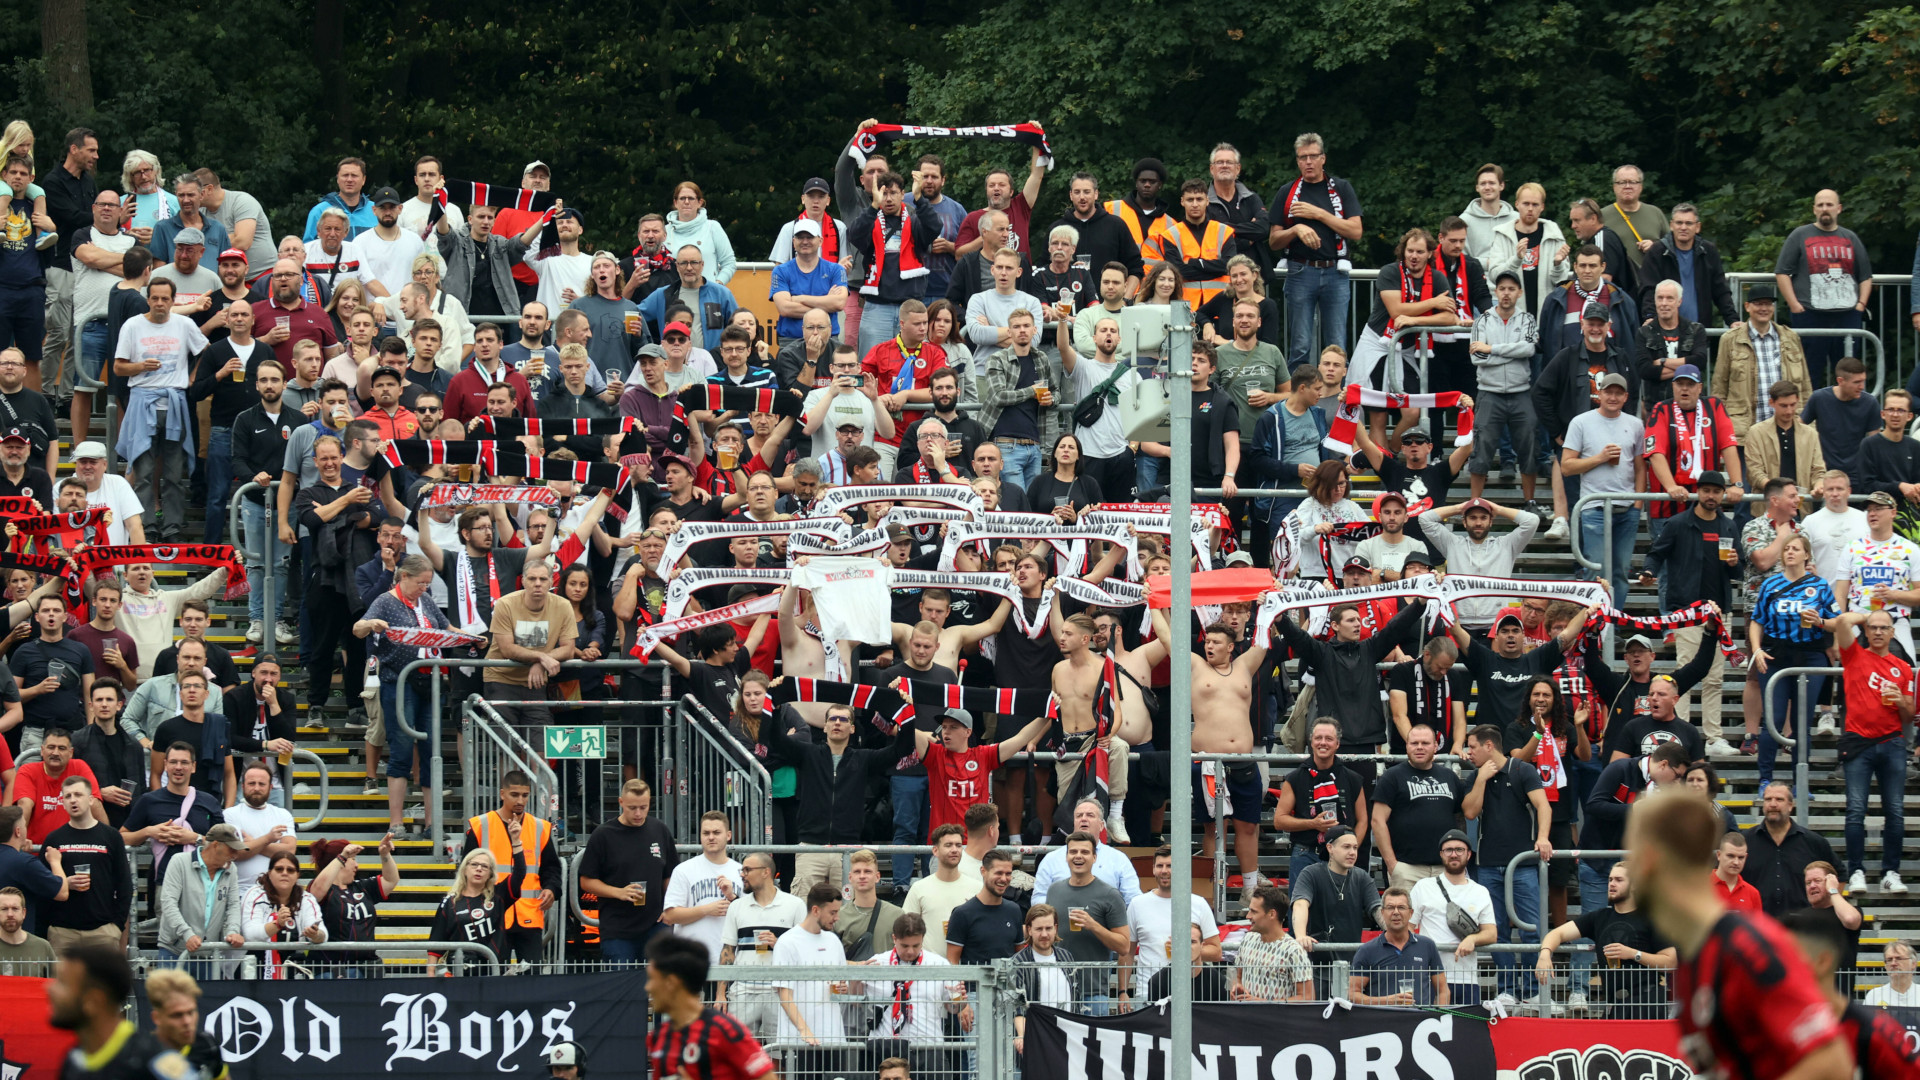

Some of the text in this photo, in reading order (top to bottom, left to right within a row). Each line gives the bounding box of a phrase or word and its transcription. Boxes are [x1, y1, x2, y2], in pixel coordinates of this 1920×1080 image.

[829, 491, 843, 505] FC
[842, 488, 897, 500] VIKTORIA
[930, 487, 958, 498] 1904
[903, 509, 918, 520] FC
[1008, 515, 1036, 526] 1904
[688, 524, 704, 537] FC
[705, 522, 759, 534] VIKTORIA
[794, 520, 821, 530] 1904
[1105, 524, 1120, 536] FC
[679, 572, 695, 586] FC
[693, 568, 749, 581] VIKTORIA
[829, 569, 870, 582] VIKTORIA
[962, 574, 991, 586] 1904
[992, 576, 1011, 591] e.V.
[1863, 568, 1894, 580] CALM
[1277, 592, 1292, 603] FC
[1294, 589, 1344, 601] VIKTORIA
[1375, 581, 1399, 592] 1904
[1401, 578, 1419, 589] e.V.
[1451, 579, 1466, 591] FC
[1467, 579, 1518, 591] VIKTORIA
[1551, 584, 1577, 595] 1904
[1577, 586, 1597, 600] e.V.
[1558, 676, 1590, 695] ETL
[948, 779, 979, 798] ETL
[464, 917, 496, 942] ETL
[204, 991, 576, 1073] Old Boys
